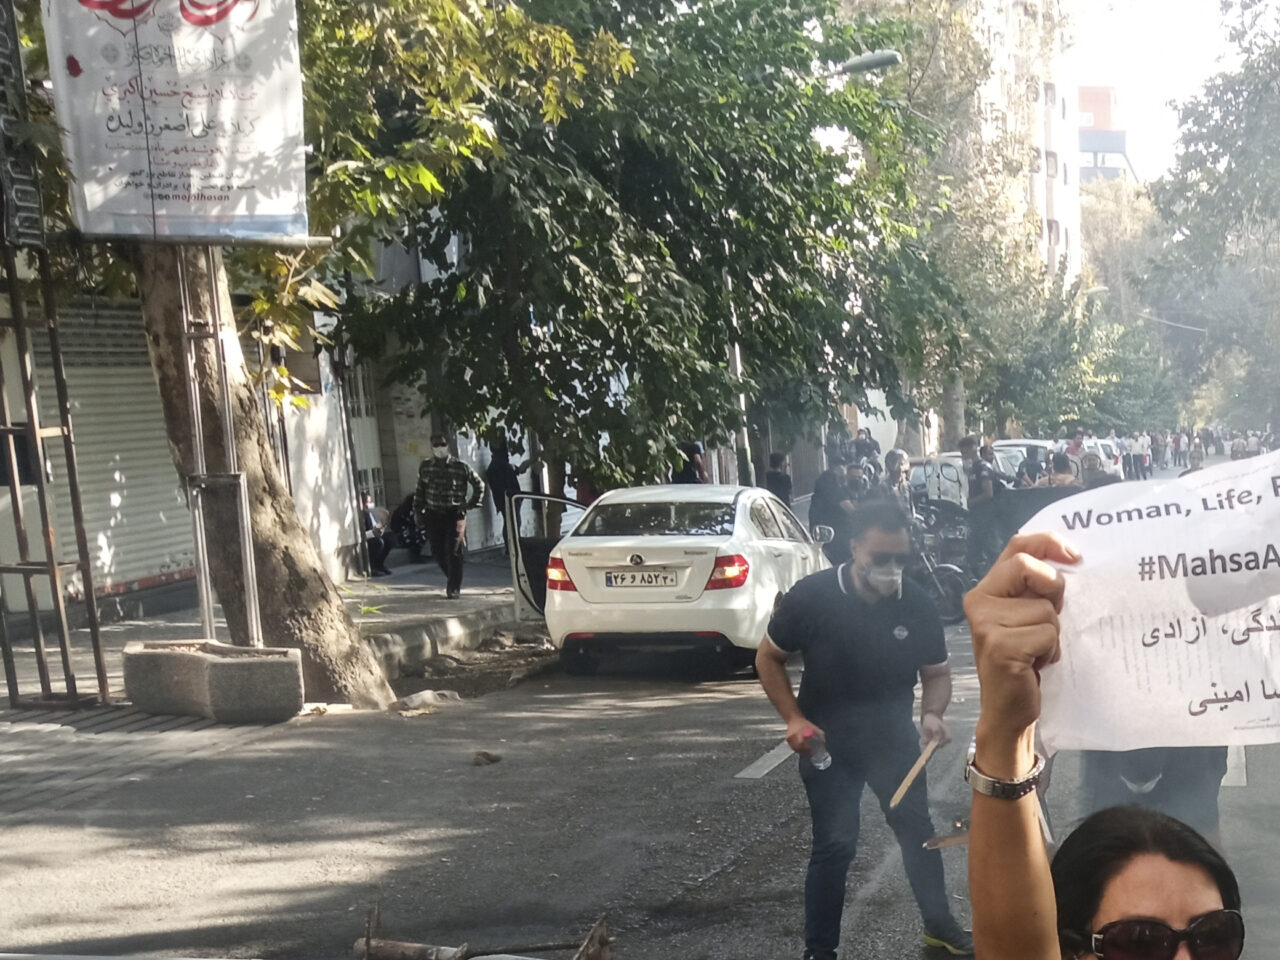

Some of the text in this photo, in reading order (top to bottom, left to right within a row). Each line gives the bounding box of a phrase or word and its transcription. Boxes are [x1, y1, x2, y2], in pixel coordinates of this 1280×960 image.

[1061, 500, 1193, 531] Woman,
[1202, 487, 1264, 512] Life,
[1188, 680, 1250, 716] امینی
